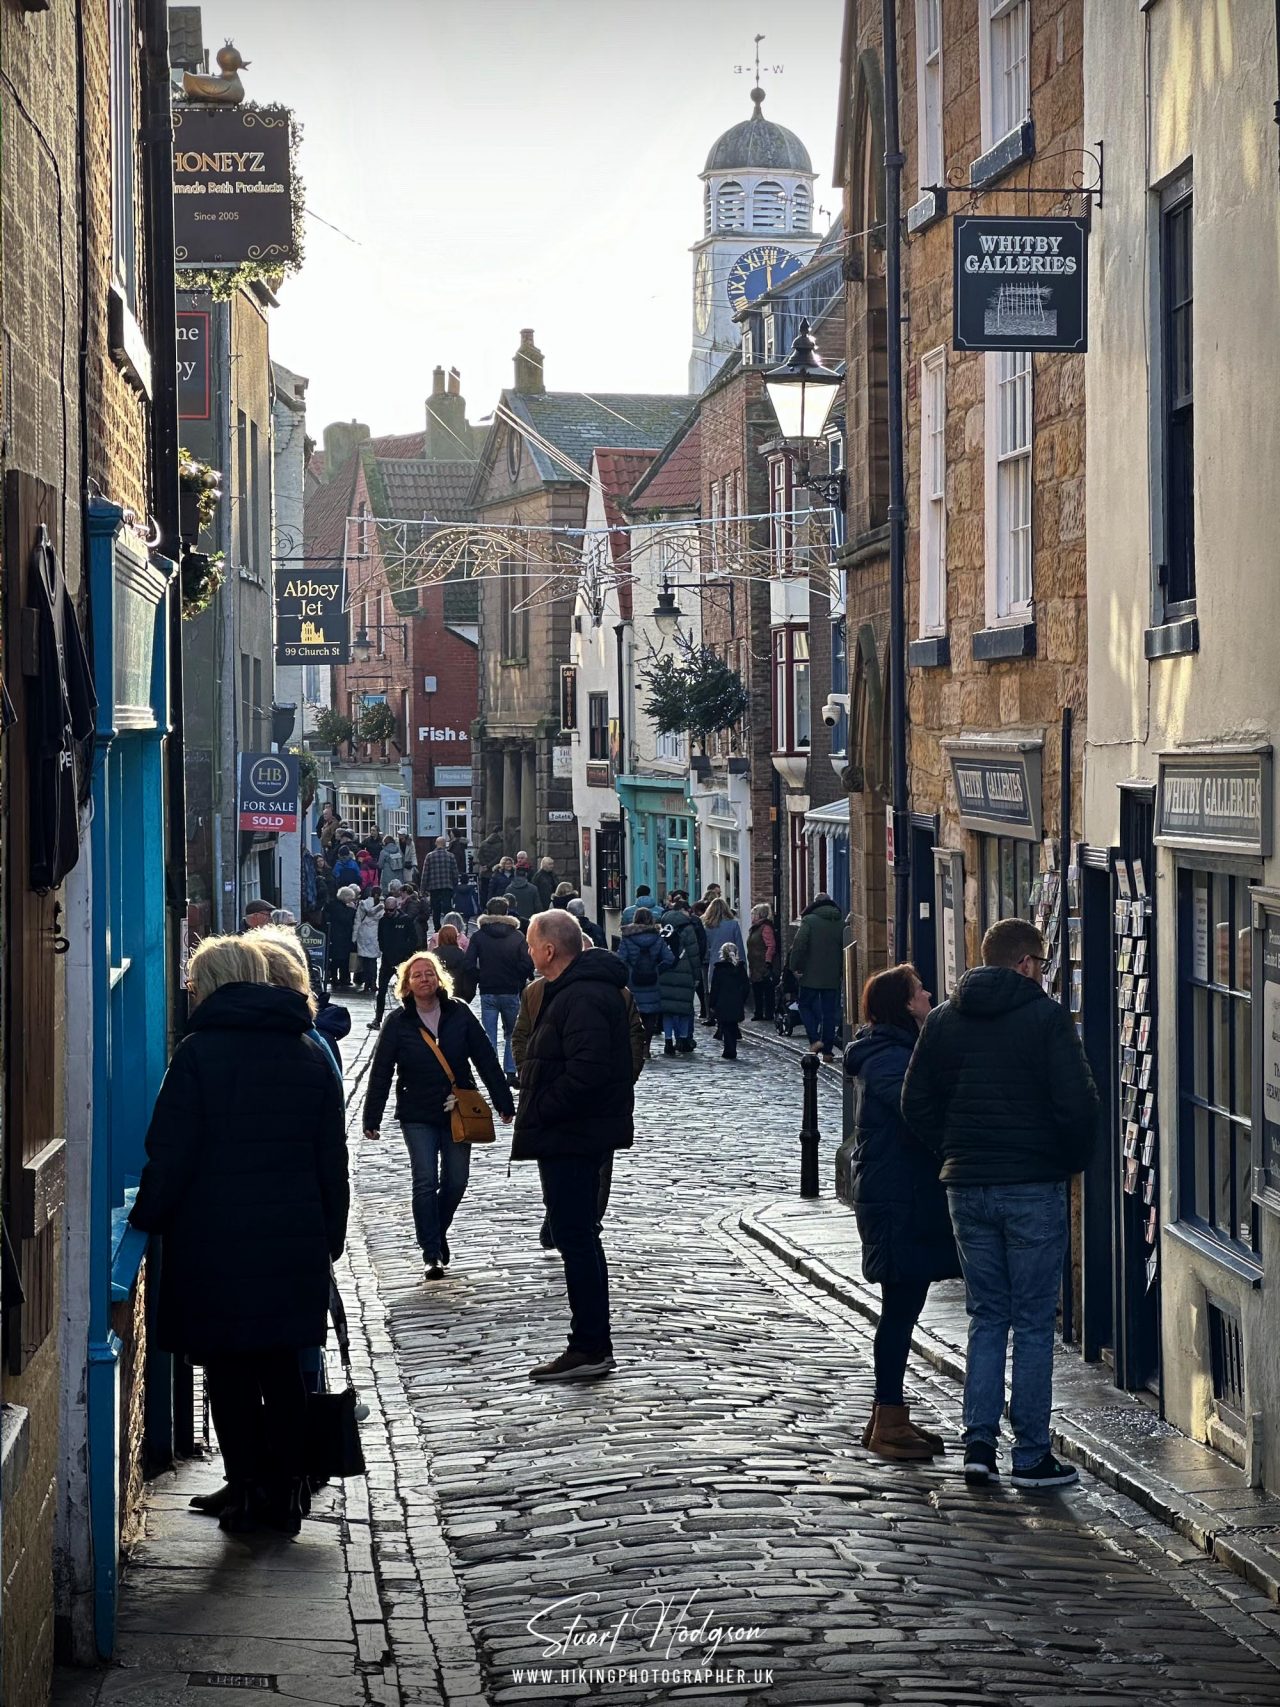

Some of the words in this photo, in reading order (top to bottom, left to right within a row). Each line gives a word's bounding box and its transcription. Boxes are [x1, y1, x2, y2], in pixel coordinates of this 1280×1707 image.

[208, 181, 234, 194] Bath
[235, 181, 285, 193] Products
[194, 212, 216, 221] Since
[218, 212, 240, 221] 2005
[979, 235, 1063, 255] WHITBY
[964, 255, 1078, 275] GALLERIES
[283, 580, 340, 601] Abbey
[298, 599, 324, 620] Jet
[285, 647, 297, 656] 99
[298, 647, 330, 656] Church
[331, 647, 340, 656] St
[418, 727, 456, 741] Fish
[458, 731, 469, 741] &
[258, 767, 282, 781] HB
[957, 770, 985, 799] WHITBY
[985, 771, 1024, 802] GALLERIES
[1163, 777, 1202, 814] WHITBY
[1203, 777, 1260, 819] GALLERIES
[243, 801, 267, 811] FOR
[269, 802, 295, 812] SALE
[252, 816, 285, 827] SOLD
